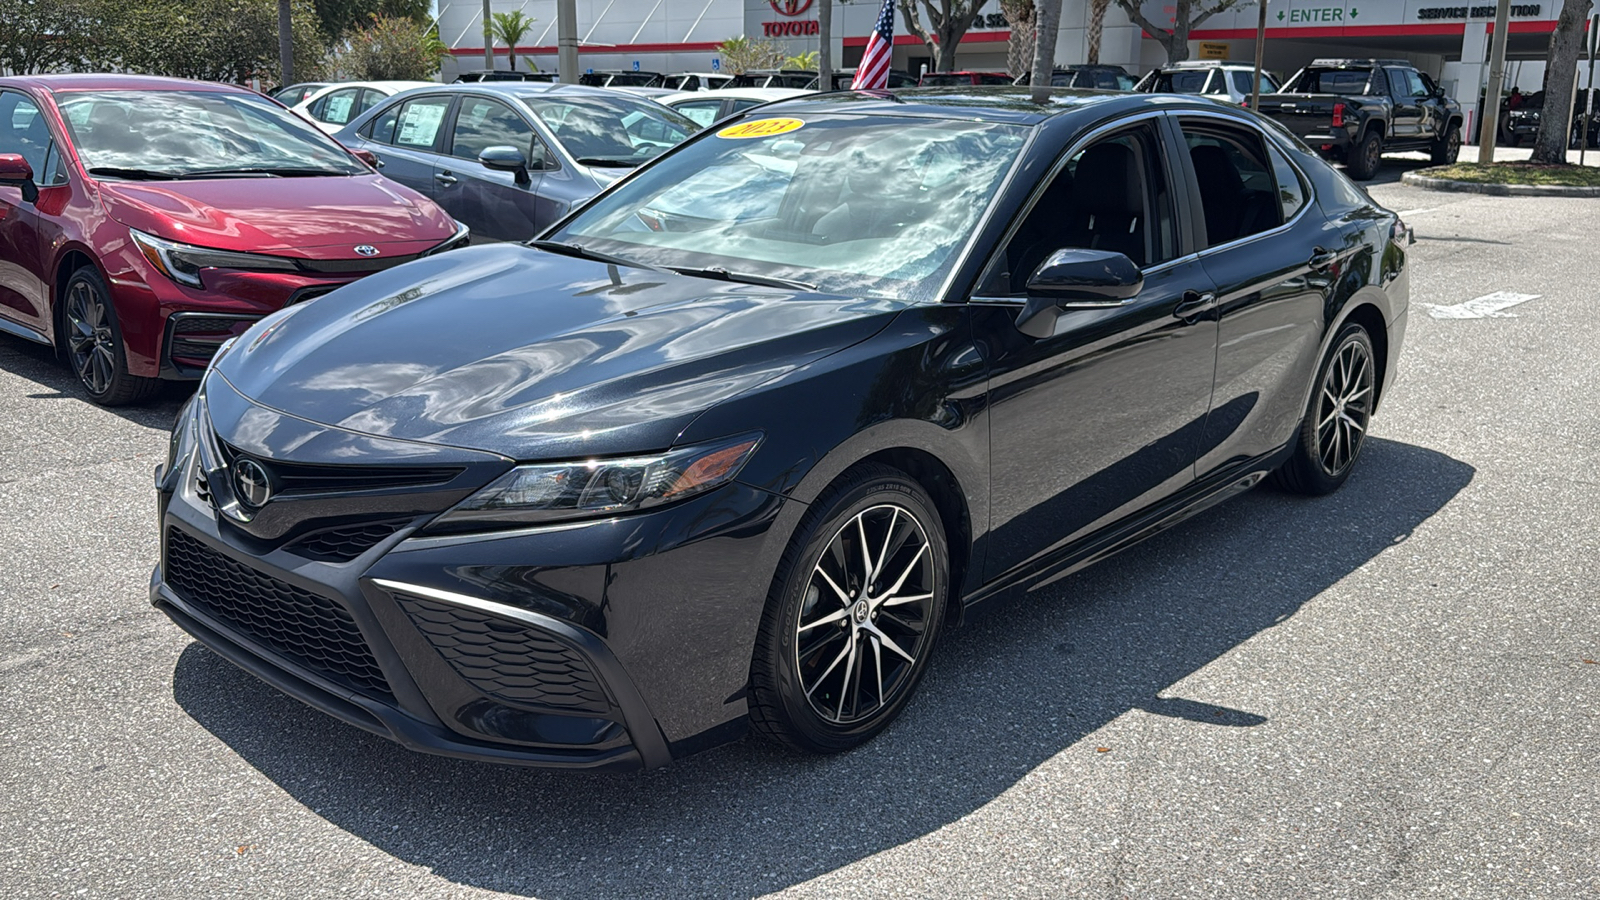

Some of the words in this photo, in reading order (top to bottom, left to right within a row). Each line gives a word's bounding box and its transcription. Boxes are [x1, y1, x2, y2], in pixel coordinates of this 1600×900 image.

[1290, 8, 1343, 22] ENTER
[1417, 7, 1469, 20] SERVICE
[1470, 4, 1540, 18] RECTION
[761, 20, 819, 37] TOYOTA
[973, 14, 985, 28] &
[725, 121, 794, 136] 2023
